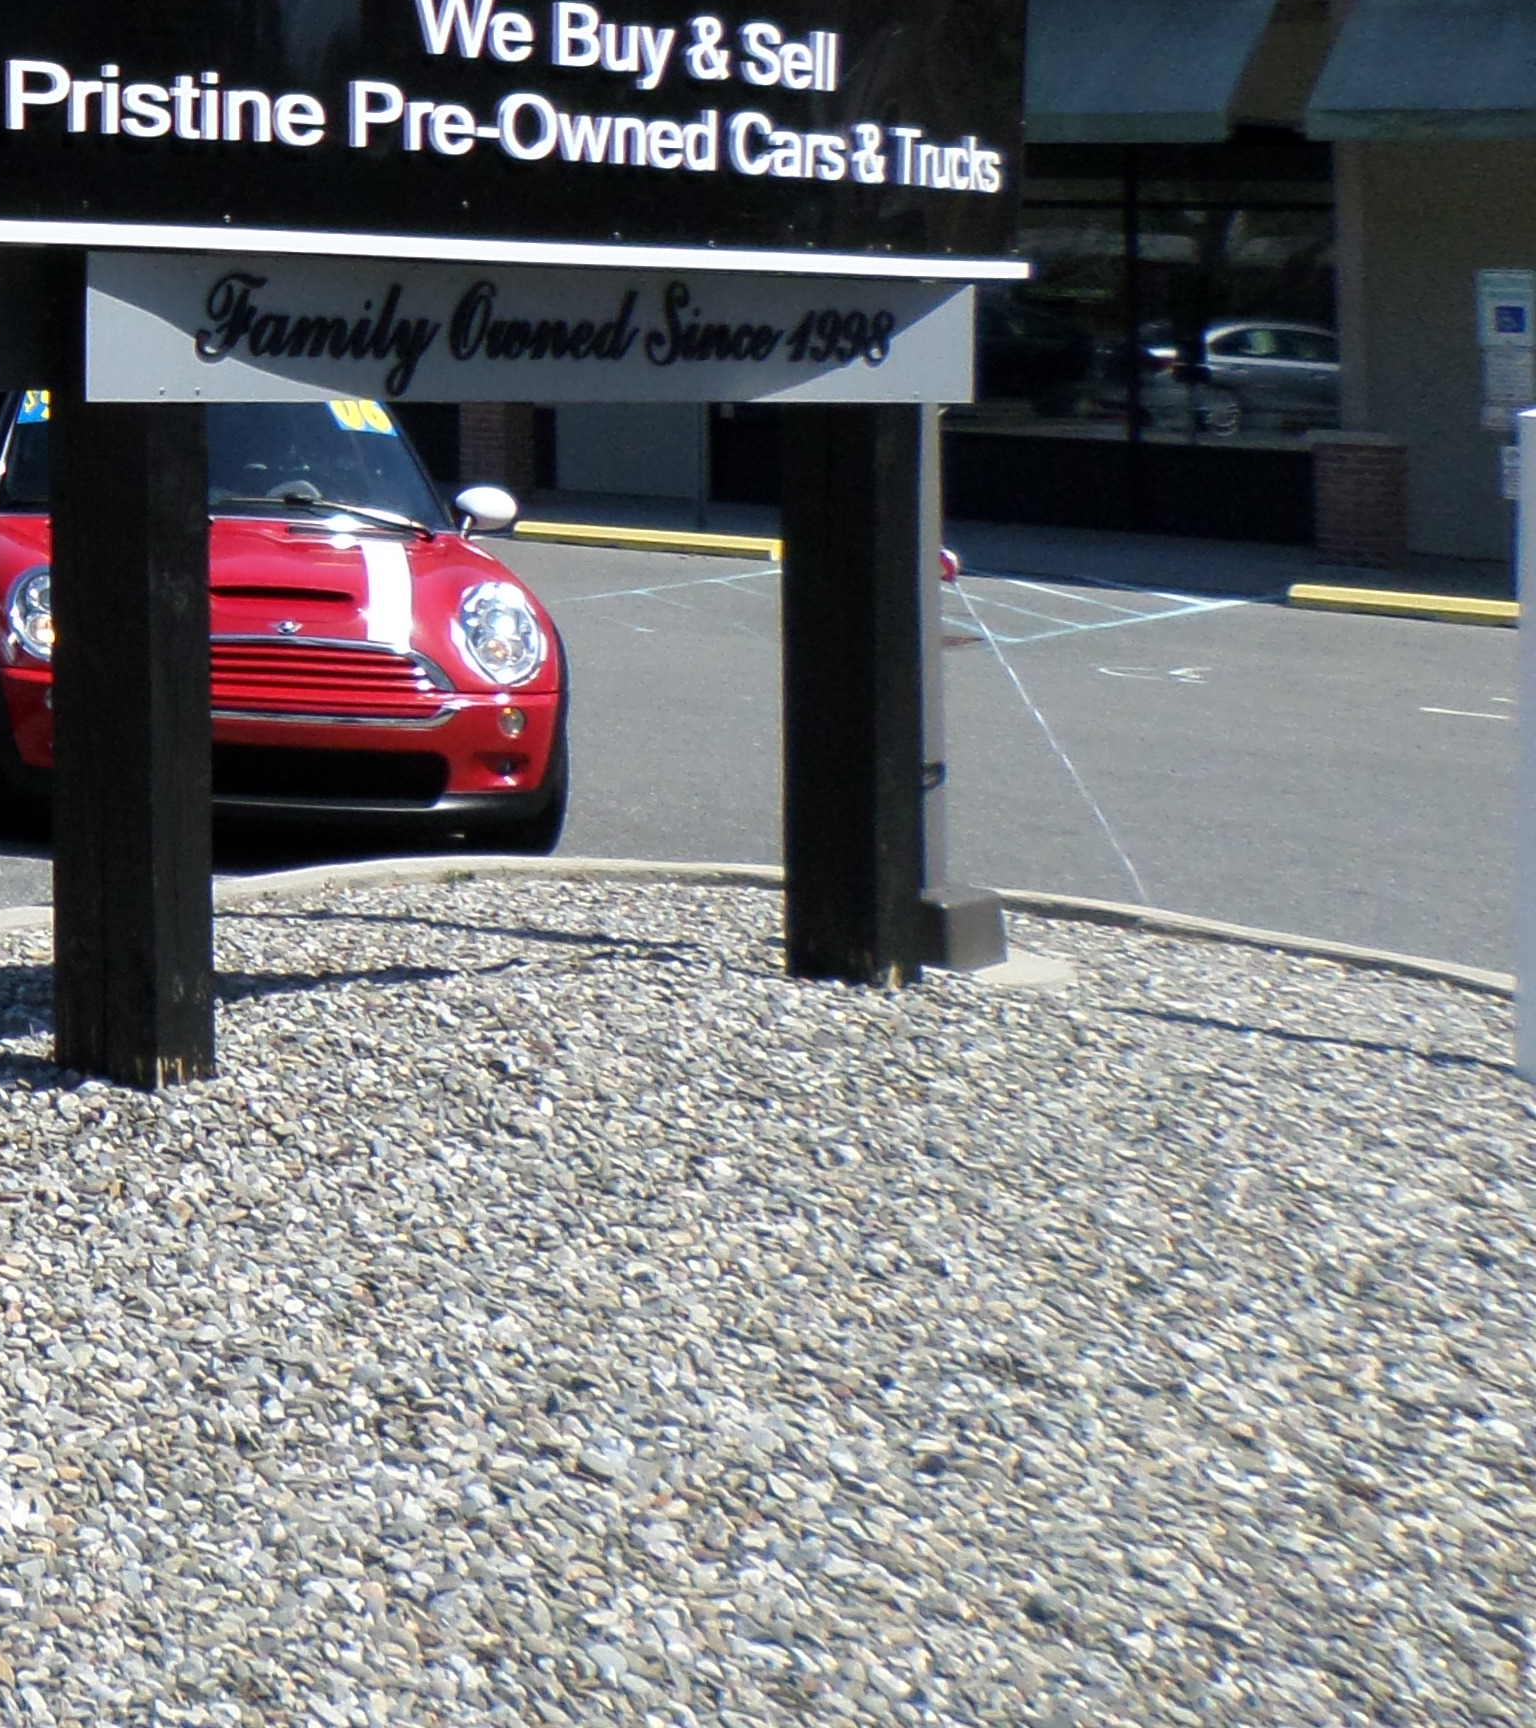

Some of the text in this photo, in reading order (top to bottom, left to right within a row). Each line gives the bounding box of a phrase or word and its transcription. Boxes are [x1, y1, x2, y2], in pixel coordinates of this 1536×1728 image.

[551, 0, 676, 91] Buy
[685, 15, 731, 81] &
[741, 21, 840, 93] Sell
[5, 58, 1004, 194] Pristine Pre-Owned Cars & Trucks
[195, 272, 897, 396] Family Owned Since 1998
